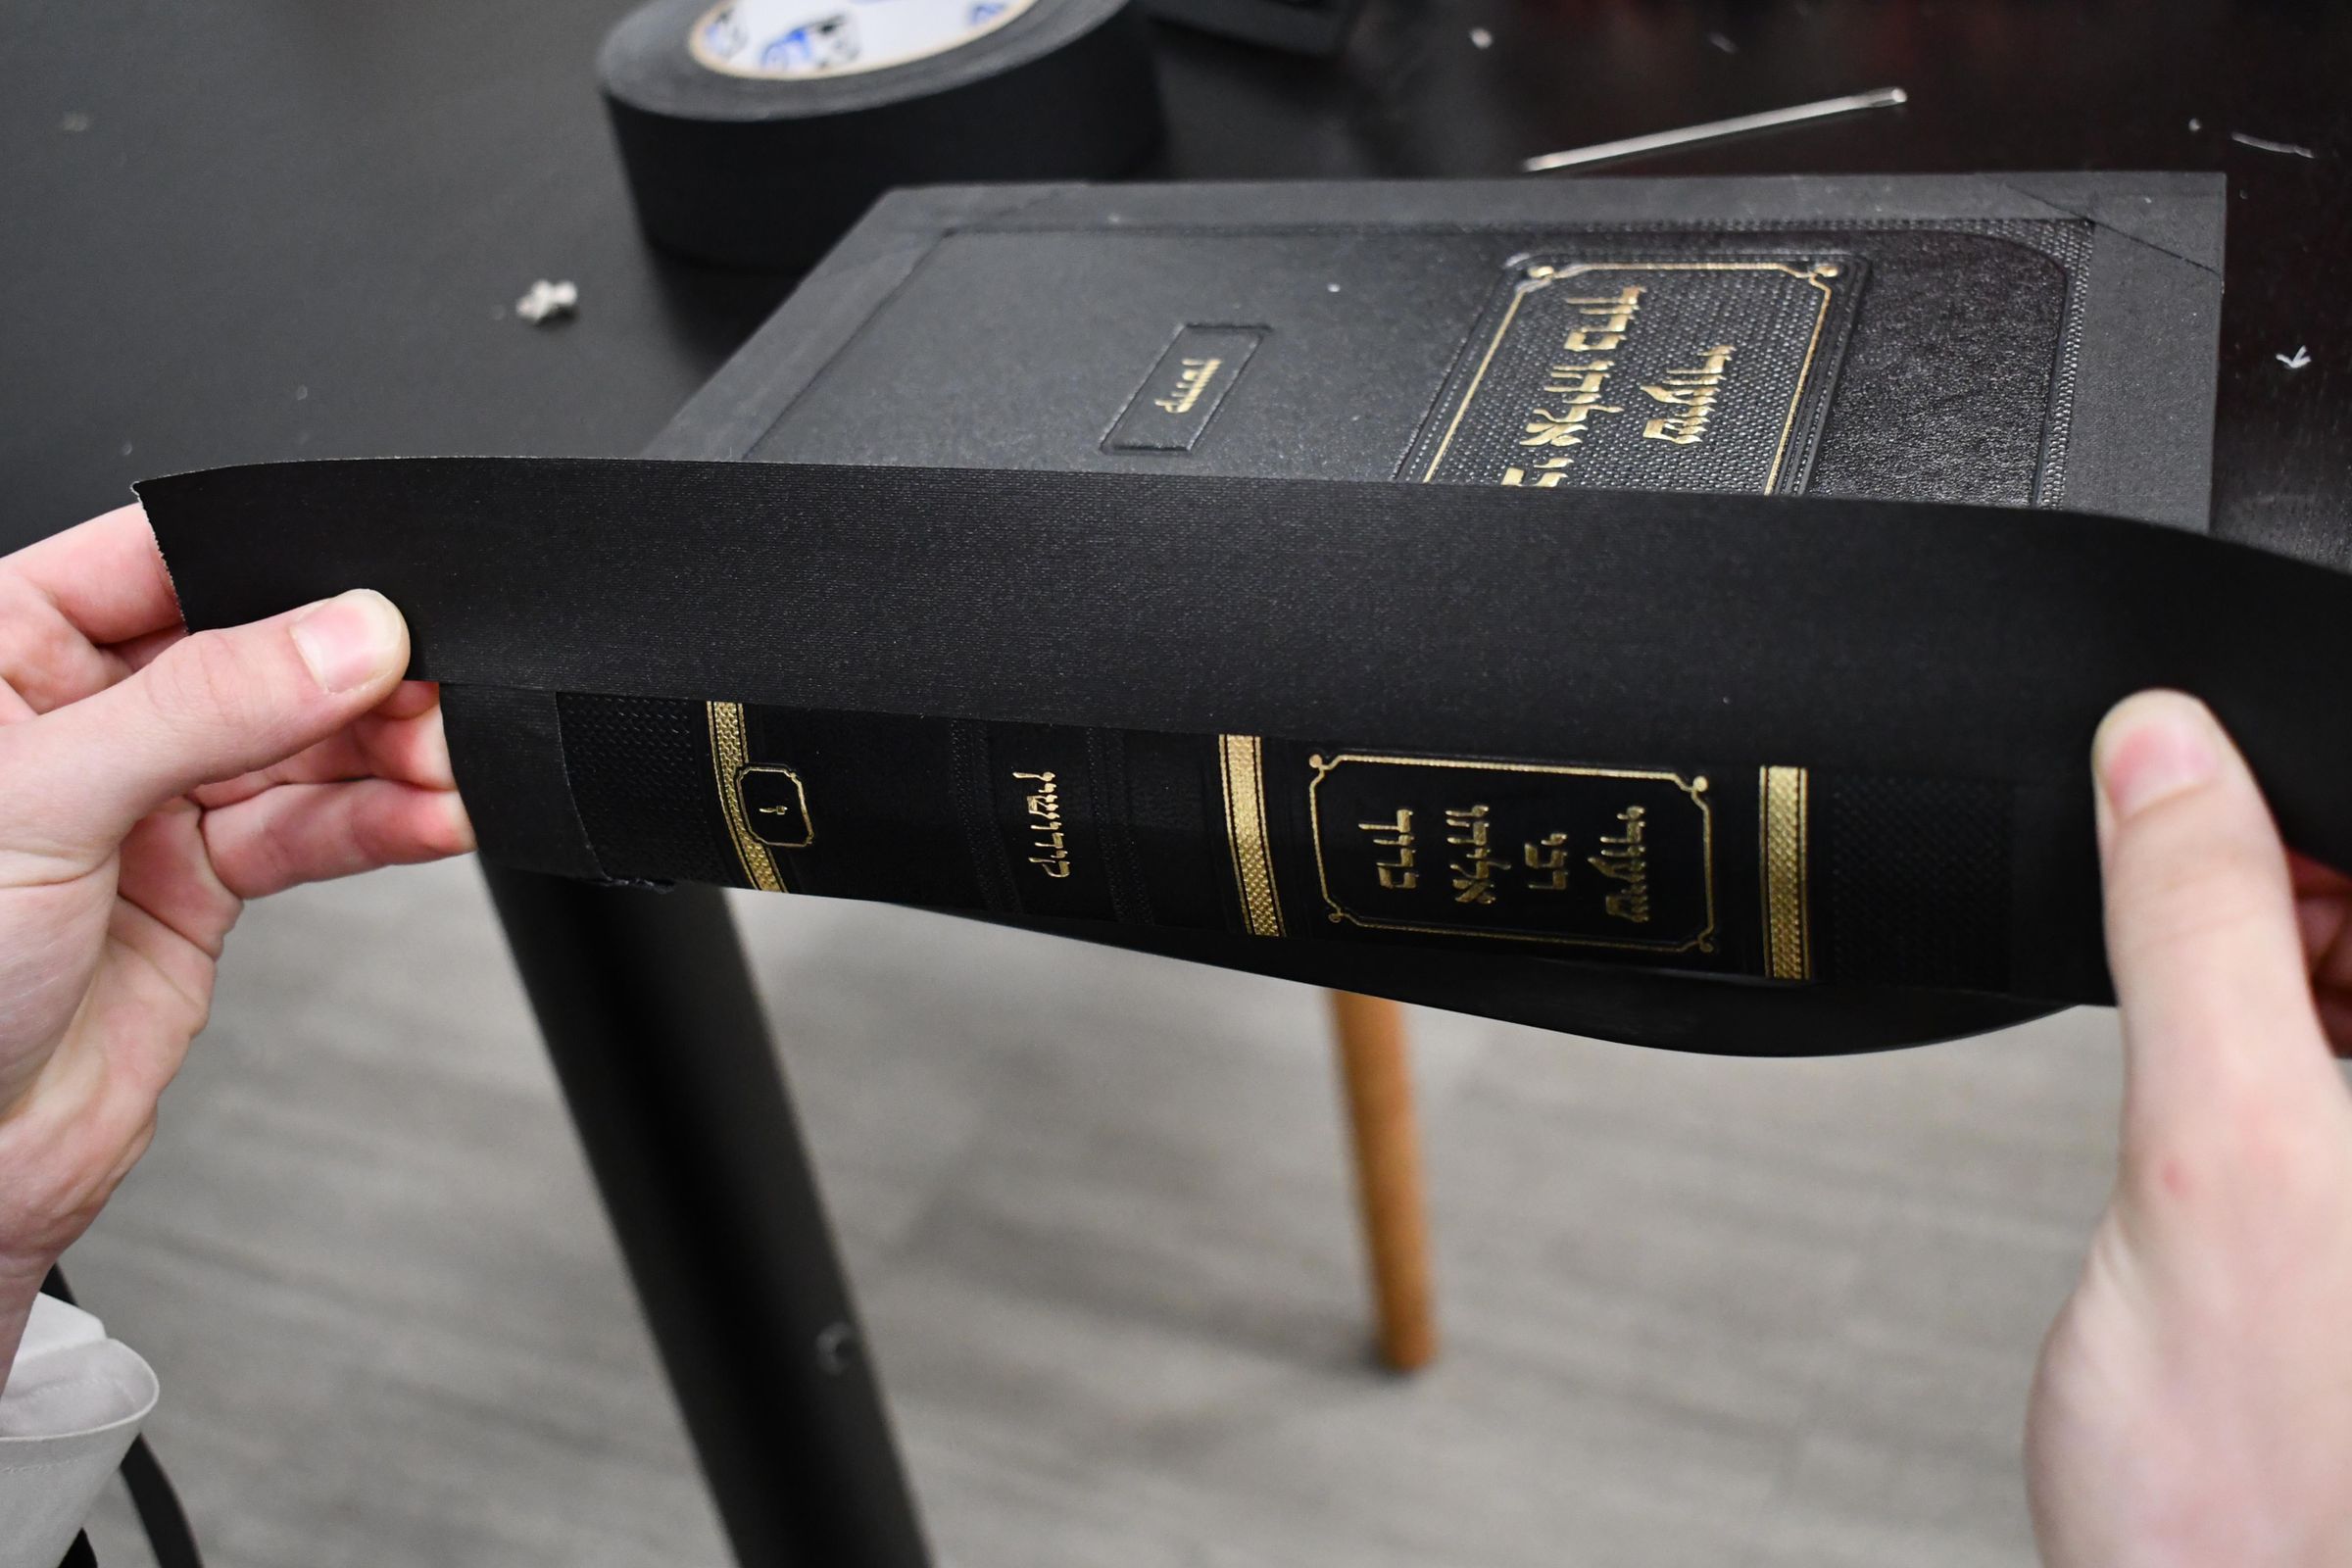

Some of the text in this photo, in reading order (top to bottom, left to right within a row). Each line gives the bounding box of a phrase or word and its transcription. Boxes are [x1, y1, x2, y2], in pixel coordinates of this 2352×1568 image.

[1500, 285, 1646, 488] בי אליהו ברוך
[1640, 345, 1736, 445] שיעורי
[1012, 771, 1070, 877] קידושין
[1358, 808, 1419, 889] ברוך
[1446, 806, 1512, 905] אליהו
[1525, 832, 1568, 890] רבי
[1588, 806, 1650, 922] שיעורי
